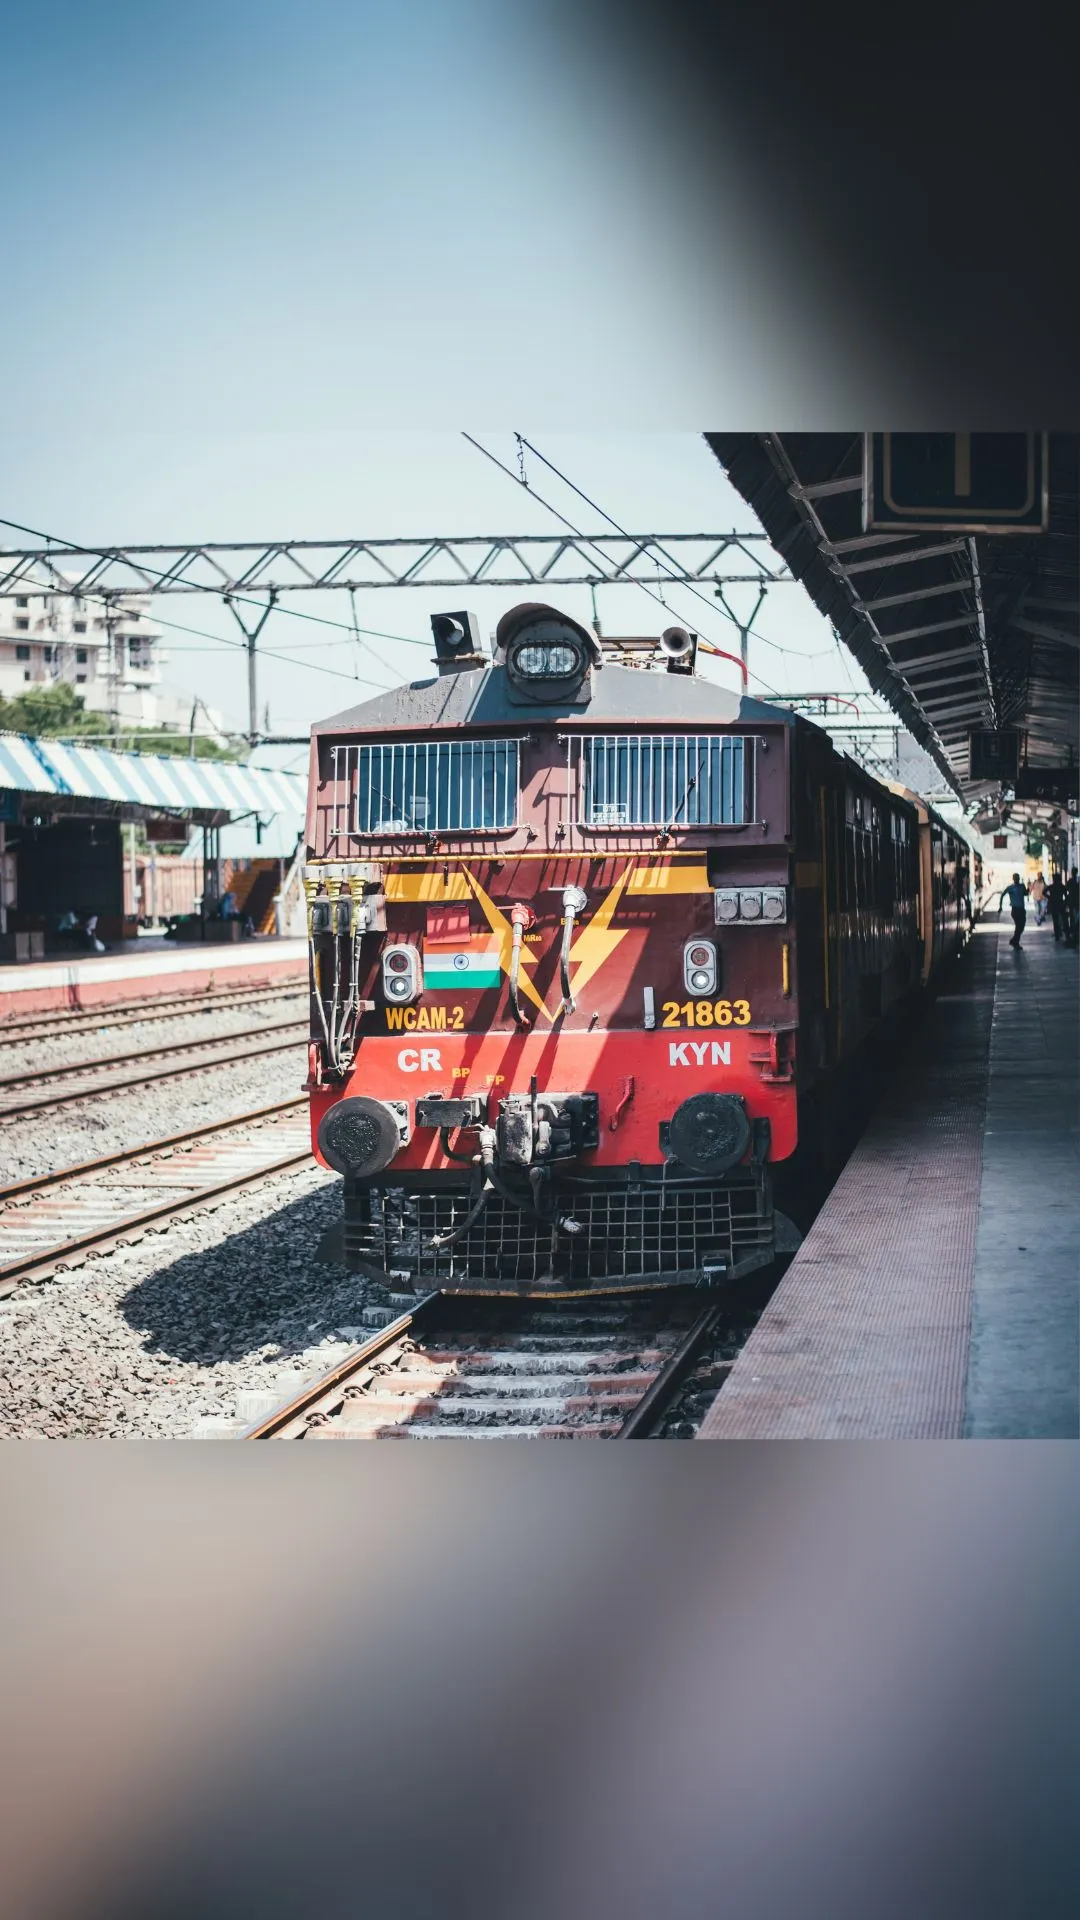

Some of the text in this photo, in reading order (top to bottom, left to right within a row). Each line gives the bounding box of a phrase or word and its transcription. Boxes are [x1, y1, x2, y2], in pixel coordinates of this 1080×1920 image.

[386, 1007, 464, 1029] WCAM-2
[662, 1000, 751, 1027] 21863
[397, 1048, 443, 1072] CR
[669, 1042, 731, 1066] KYN
[452, 1068, 470, 1078] BP
[486, 1075, 504, 1085] FP
